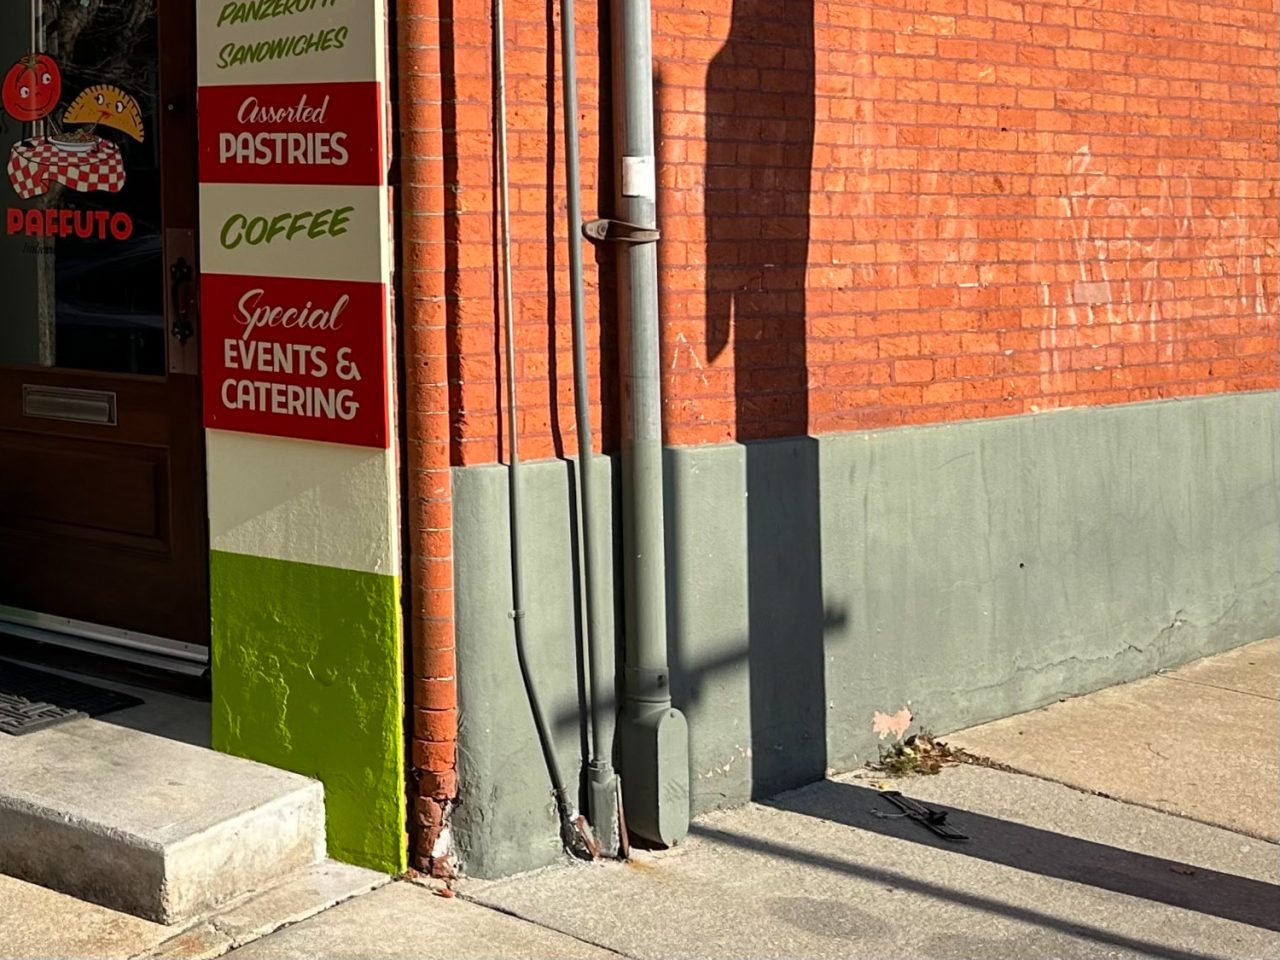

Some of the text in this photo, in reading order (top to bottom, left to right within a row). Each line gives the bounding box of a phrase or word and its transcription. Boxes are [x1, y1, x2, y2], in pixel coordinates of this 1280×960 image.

[216, 26, 348, 69] SANDWICHES
[237, 94, 330, 124] Assorted
[219, 131, 349, 166] PASTRIES
[6, 207, 133, 240] PAFFUTO
[220, 206, 355, 250] COFFEE
[233, 288, 350, 340] Special
[224, 338, 362, 381] EVENTS &
[221, 378, 360, 420] CATERING
